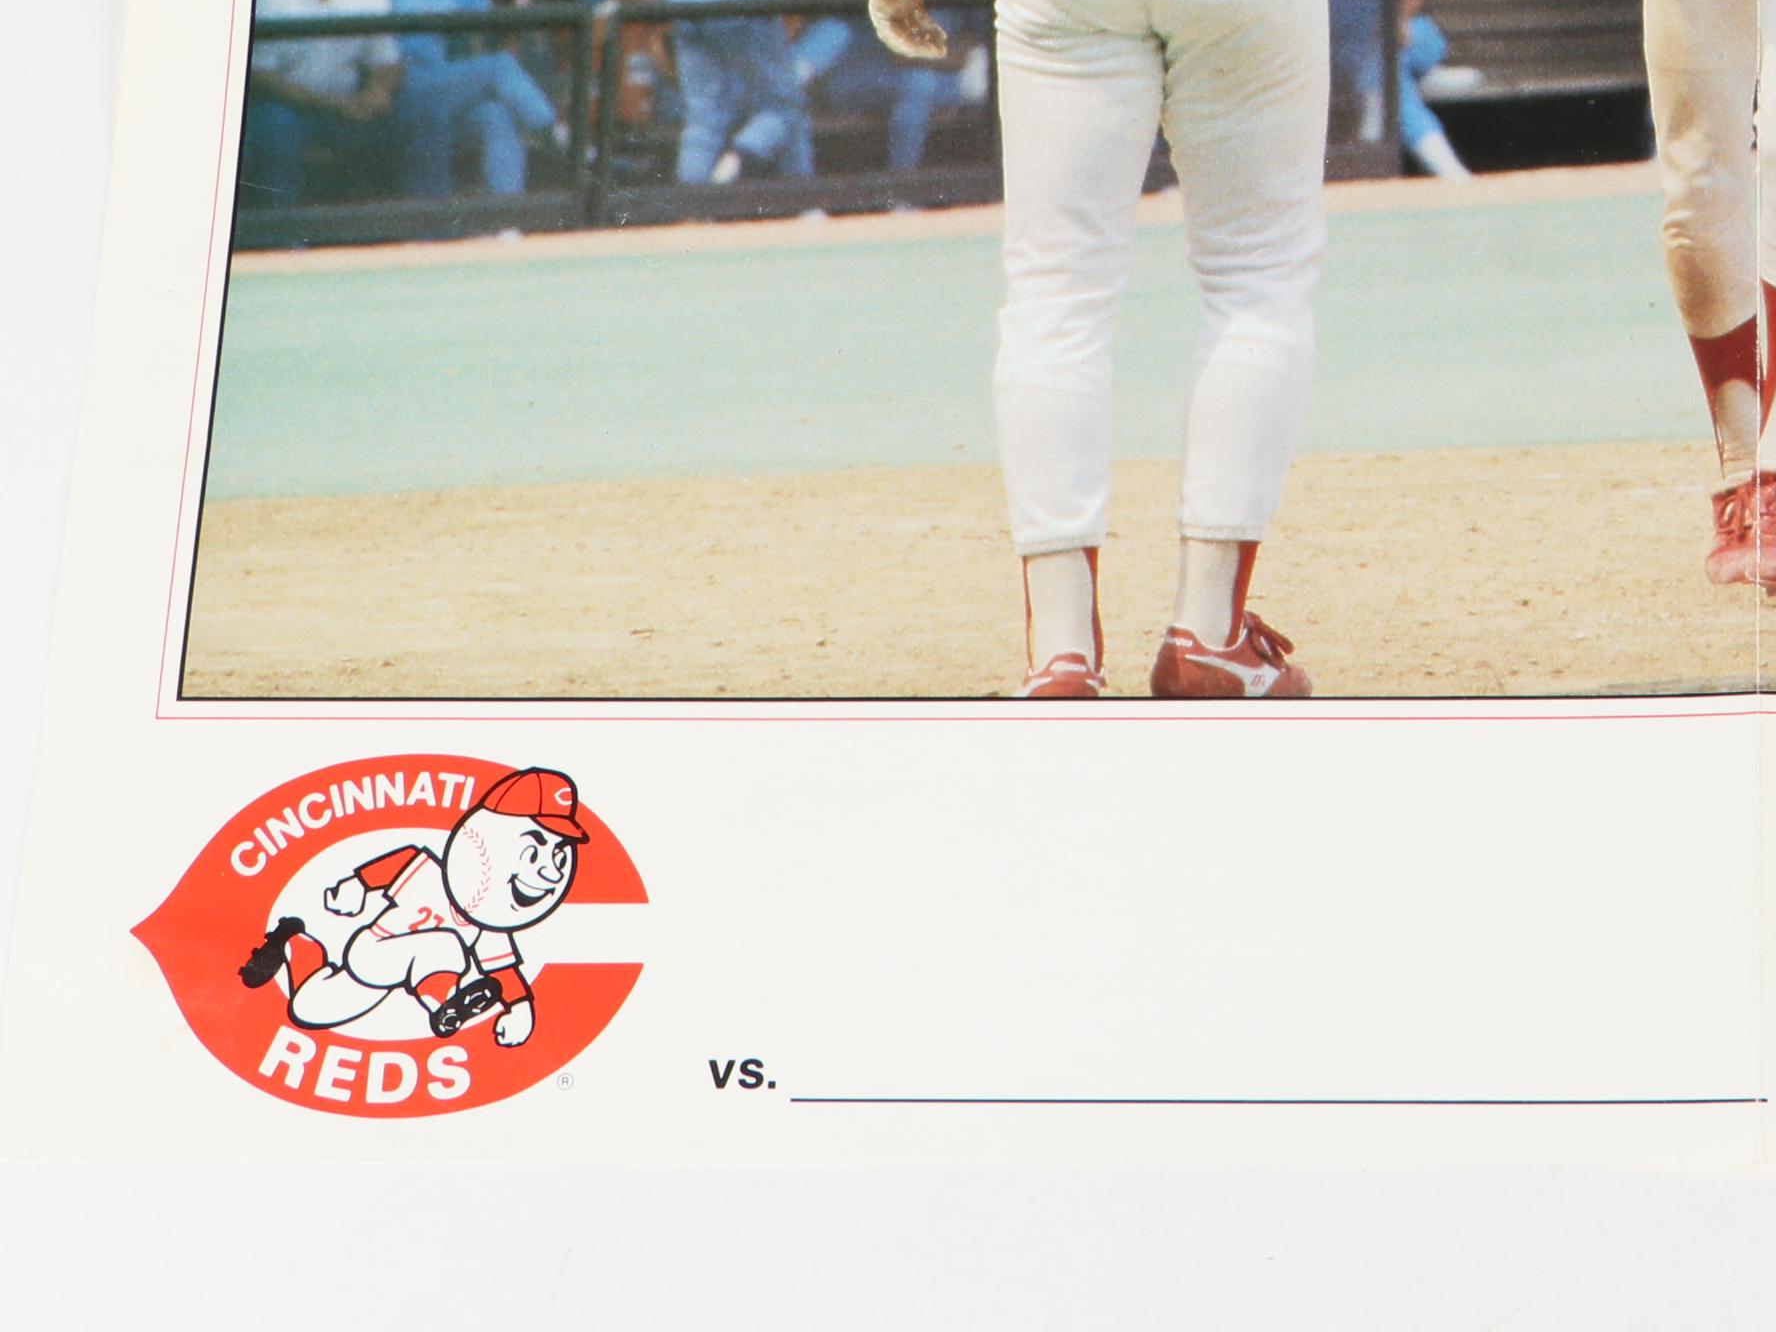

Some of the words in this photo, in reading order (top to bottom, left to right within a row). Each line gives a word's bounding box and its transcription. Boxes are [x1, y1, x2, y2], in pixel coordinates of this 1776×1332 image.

[229, 770, 476, 878] CINCINNATI
[257, 1024, 472, 1105] REDS
[708, 1058, 777, 1090] vs.
